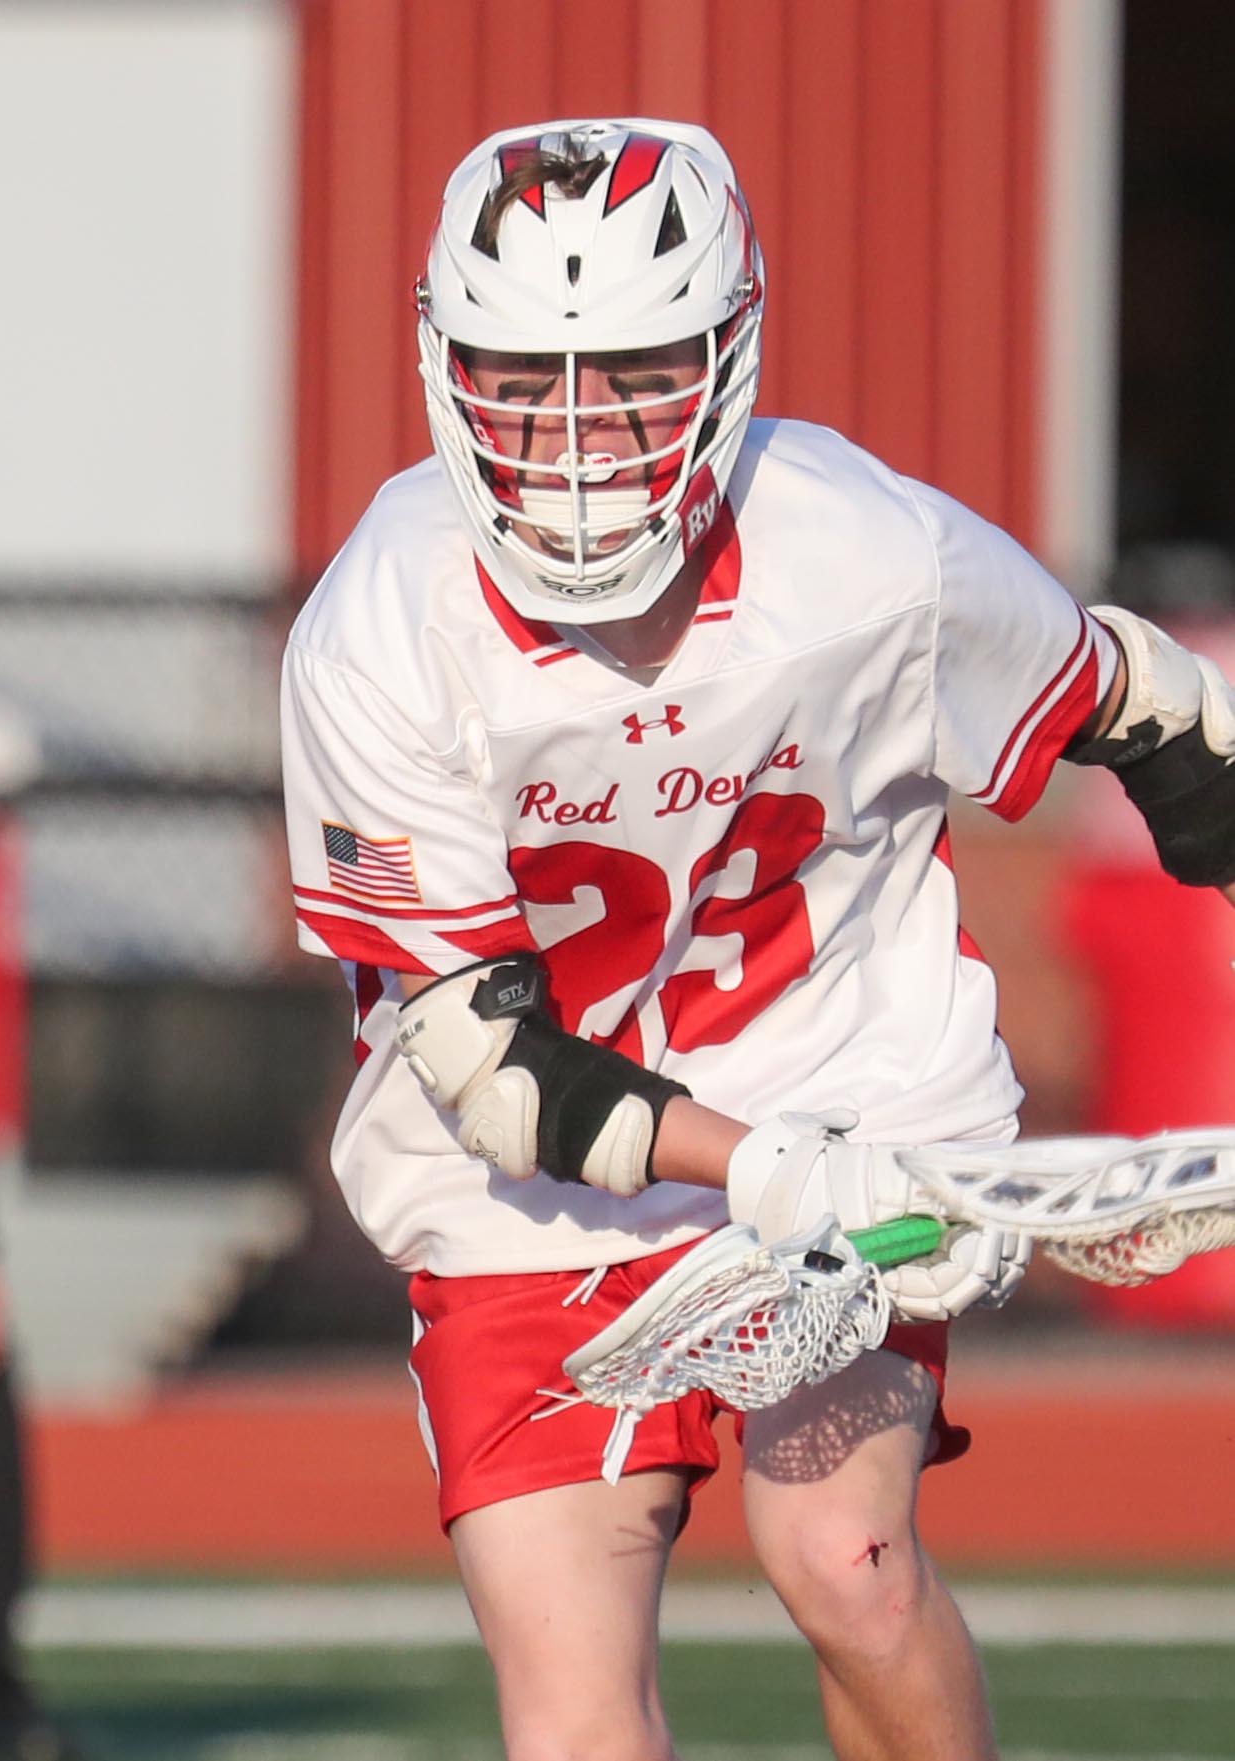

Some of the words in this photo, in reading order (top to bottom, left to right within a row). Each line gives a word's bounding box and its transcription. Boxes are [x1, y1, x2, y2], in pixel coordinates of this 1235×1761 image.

[515, 781, 620, 827] Red
[654, 743, 805, 818] Devs
[508, 791, 826, 1069] 23
[497, 981, 526, 1006] STX
